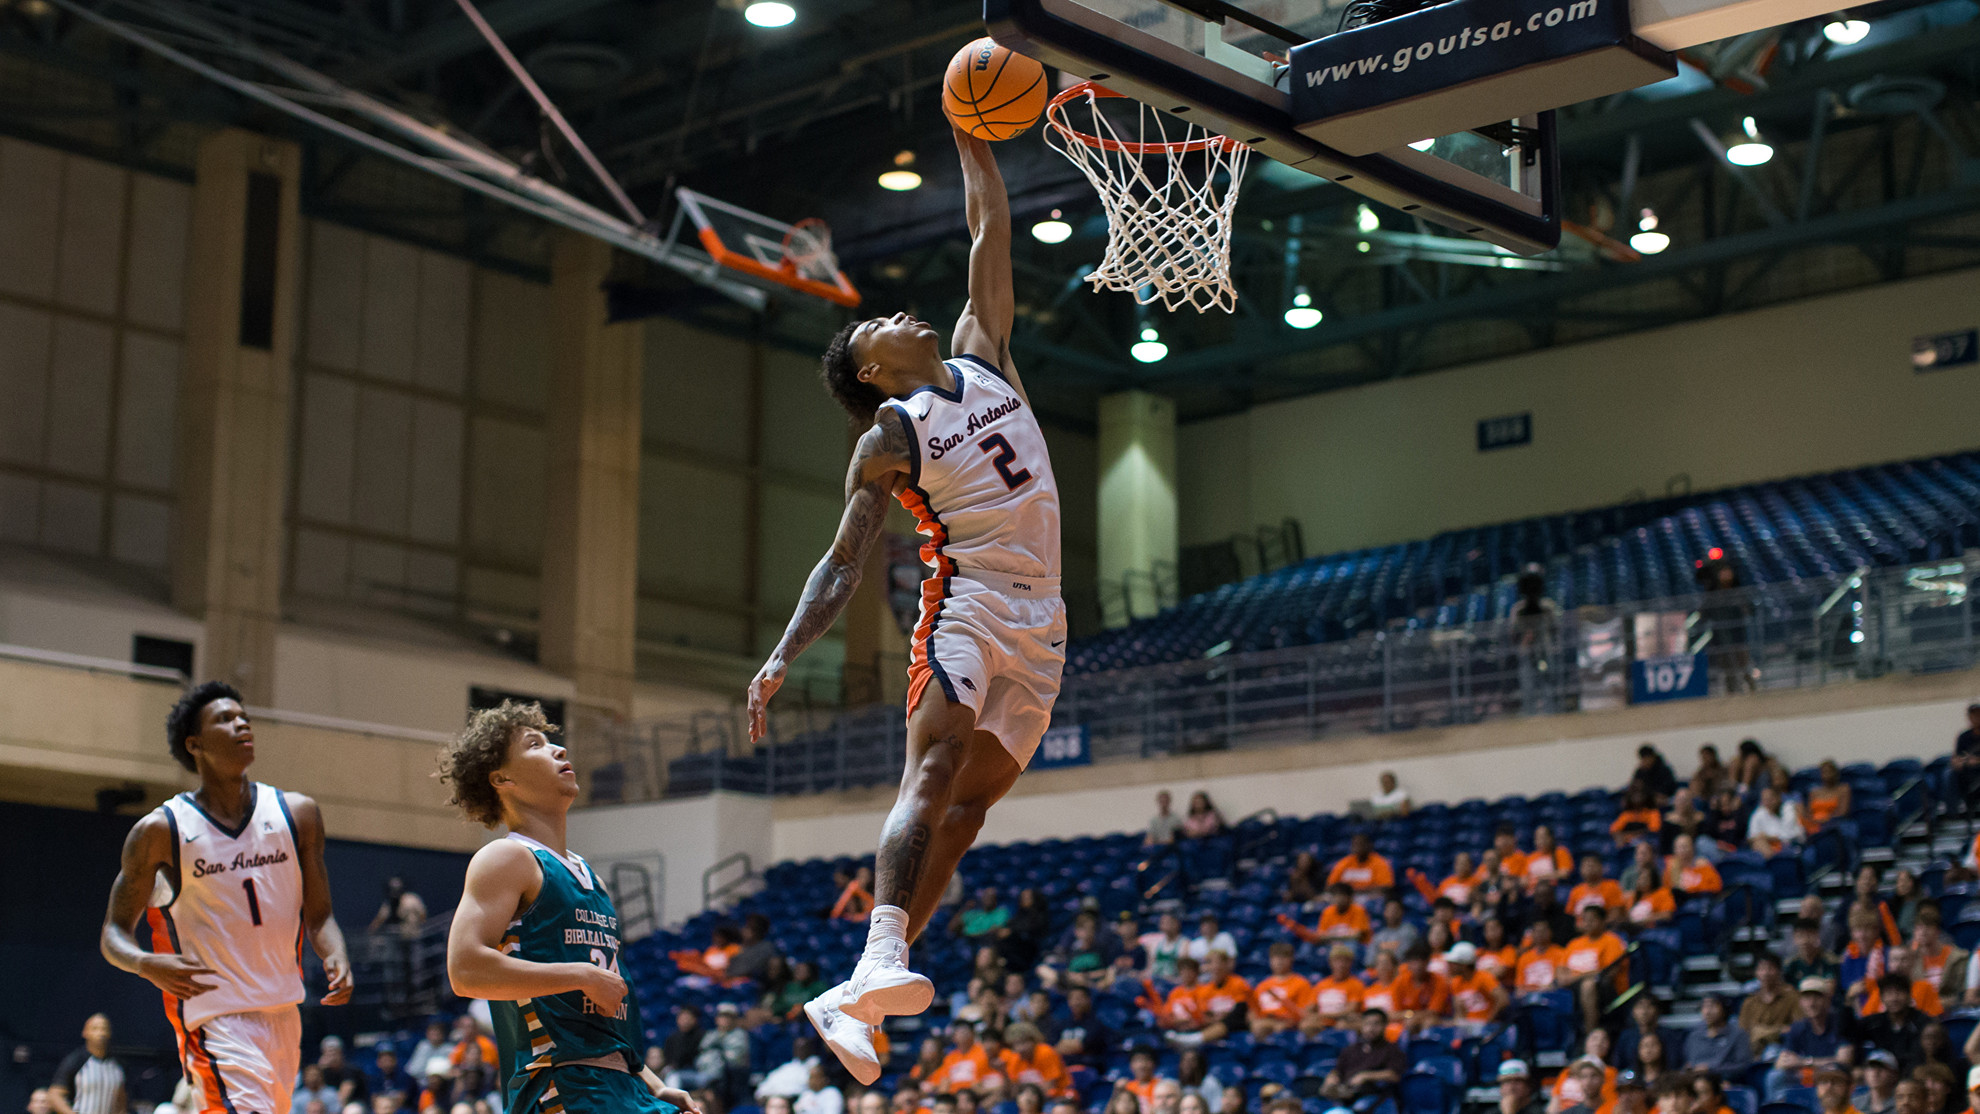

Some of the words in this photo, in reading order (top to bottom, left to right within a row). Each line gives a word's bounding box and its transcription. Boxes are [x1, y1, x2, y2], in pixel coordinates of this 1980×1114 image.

[1306, 0, 1597, 88] www.goutsa.com
[928, 433, 964, 460] San
[967, 396, 1021, 436] Antonio
[977, 432, 1033, 492] 2
[1012, 582, 1031, 591] UTSA
[1643, 664, 1693, 693] 107
[193, 858, 226, 878] San
[229, 849, 288, 871] Antonio
[242, 878, 263, 927] 1
